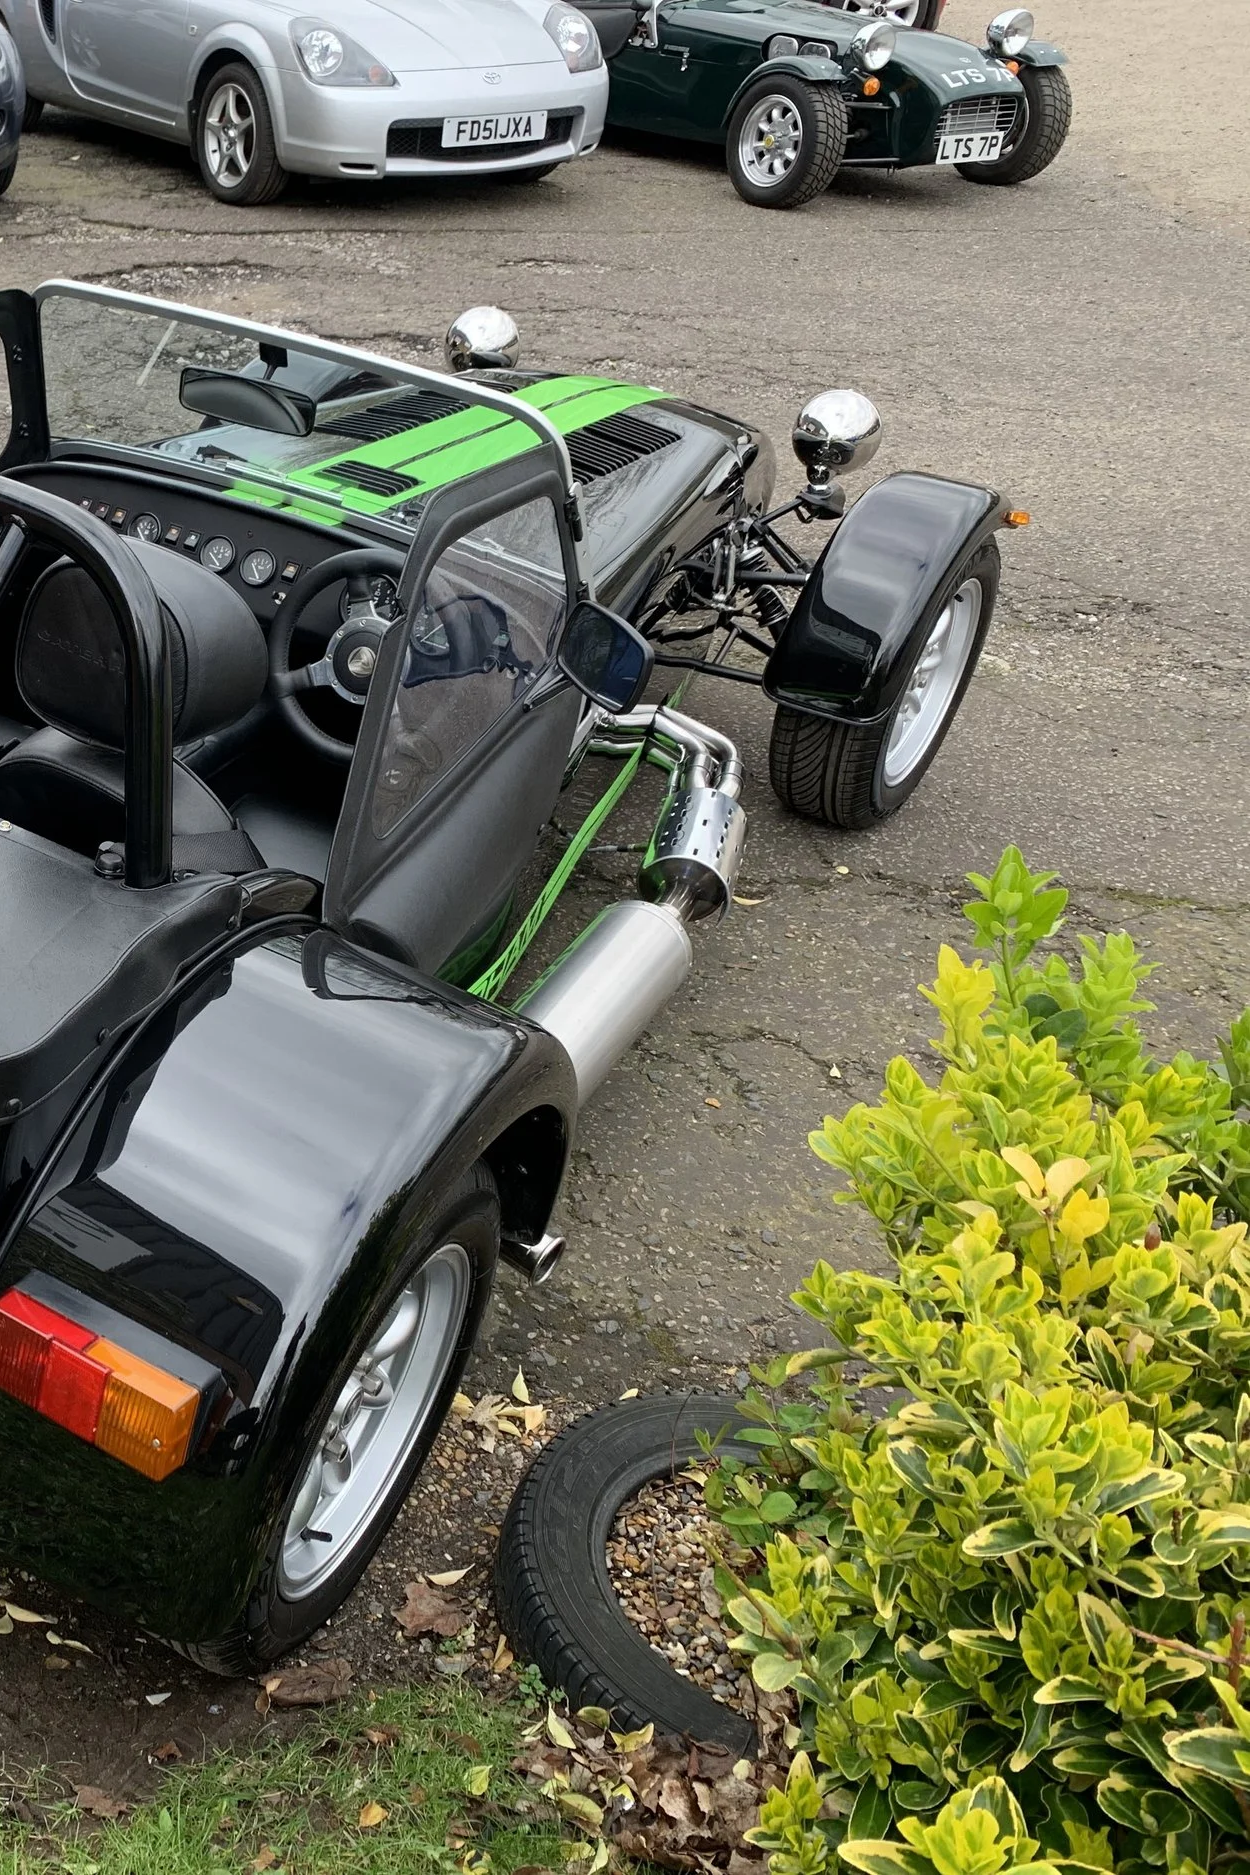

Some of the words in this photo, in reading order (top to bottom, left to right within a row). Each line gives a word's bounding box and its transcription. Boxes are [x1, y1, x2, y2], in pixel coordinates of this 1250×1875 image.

[941, 68, 987, 88] LTS
[985, 67, 1015, 82] 7P
[455, 116, 533, 142] FD51JXA
[940, 138, 975, 160] LTS
[978, 135, 1000, 156] 7P
